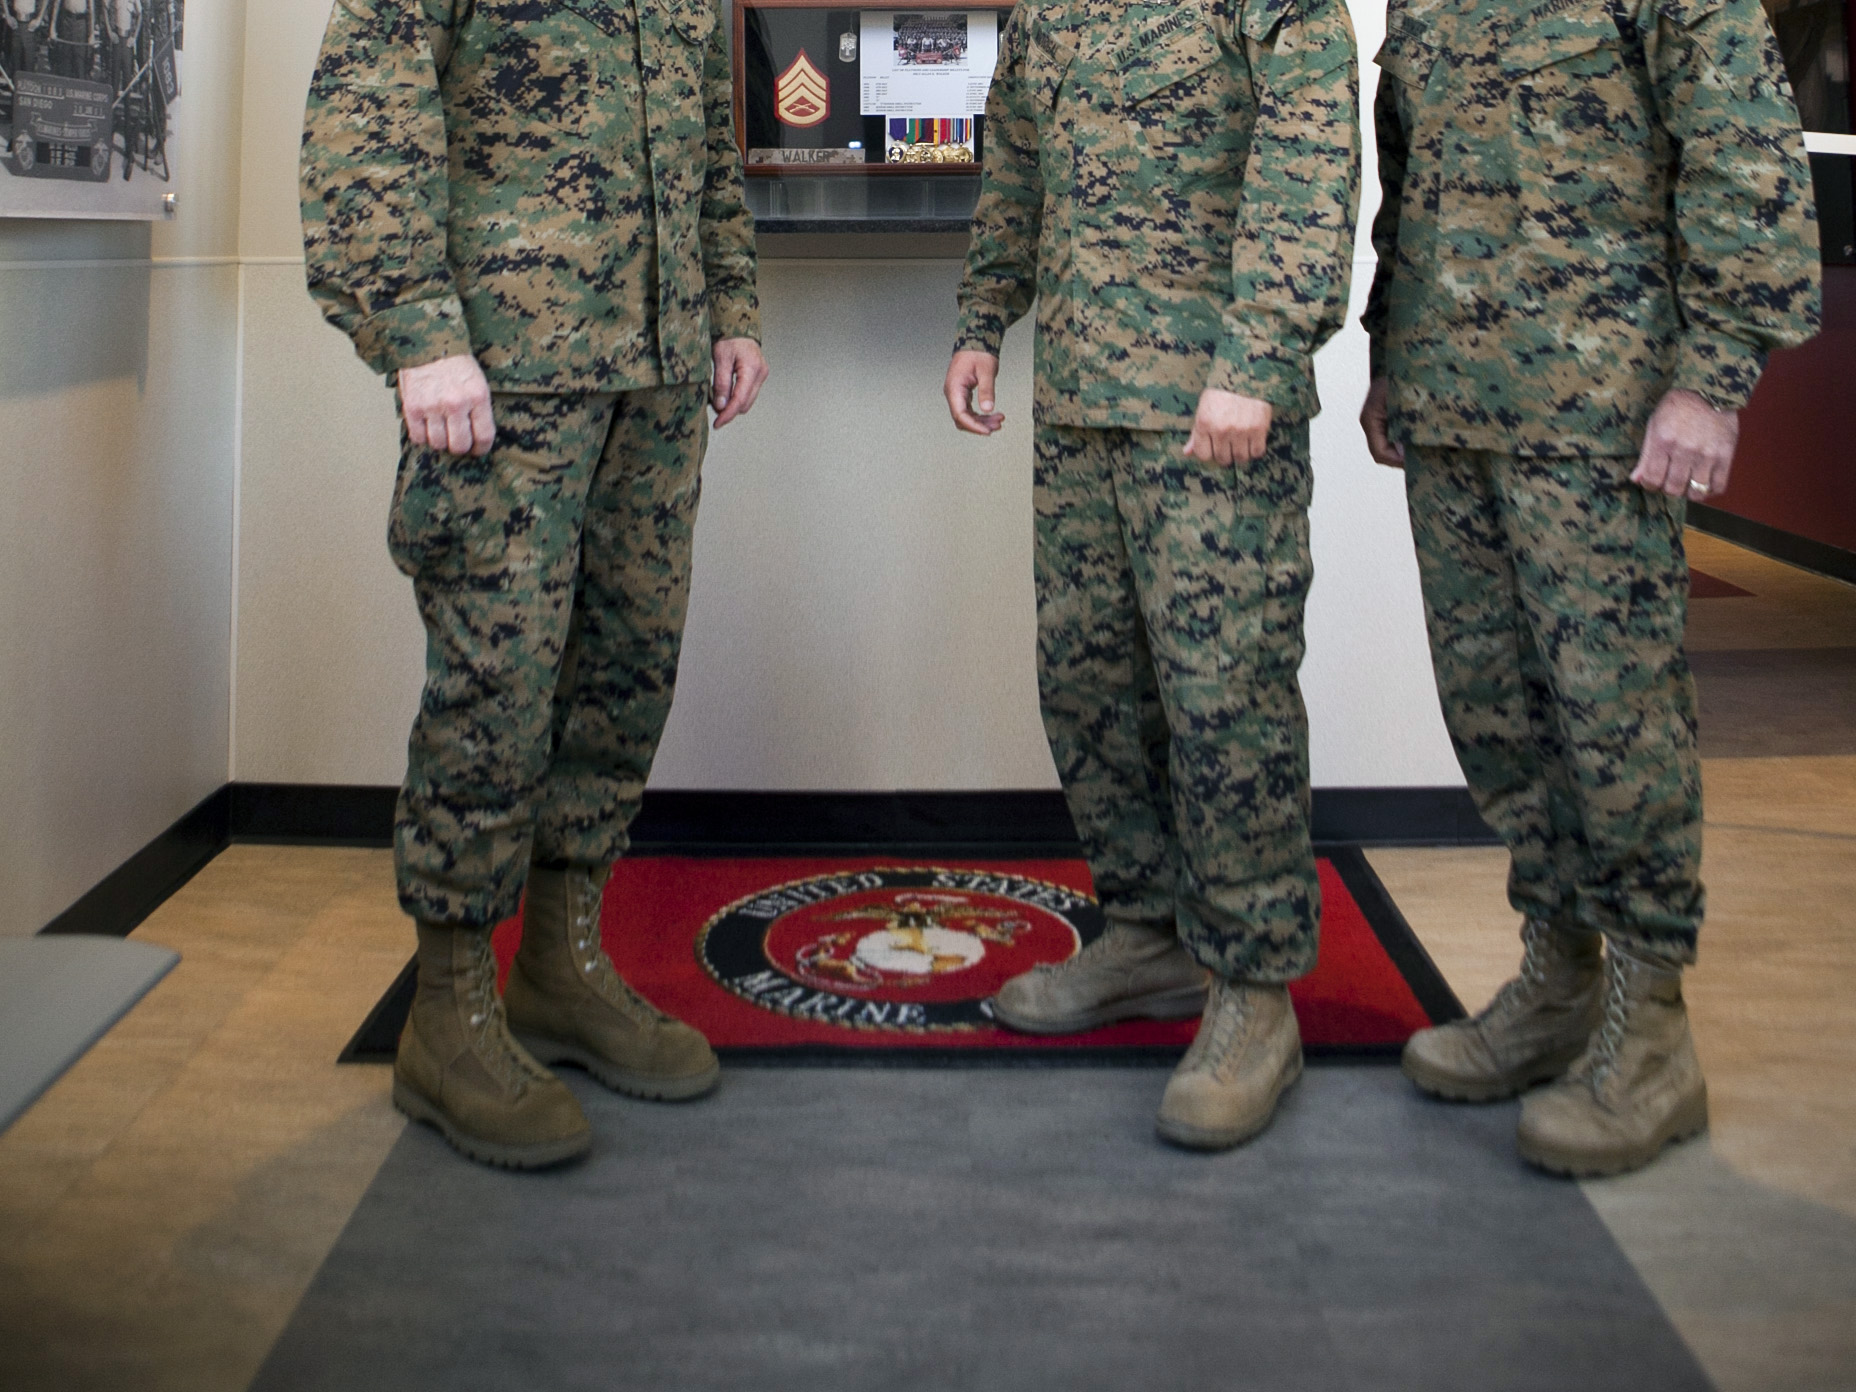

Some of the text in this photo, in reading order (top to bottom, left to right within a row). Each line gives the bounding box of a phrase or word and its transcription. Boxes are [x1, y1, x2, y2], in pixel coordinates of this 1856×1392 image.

[1117, 8, 1195, 64] U.S. MARINES
[782, 149, 830, 163] WALKER
[738, 872, 1089, 919] UNITED STATES
[733, 970, 928, 1025] MARINE
